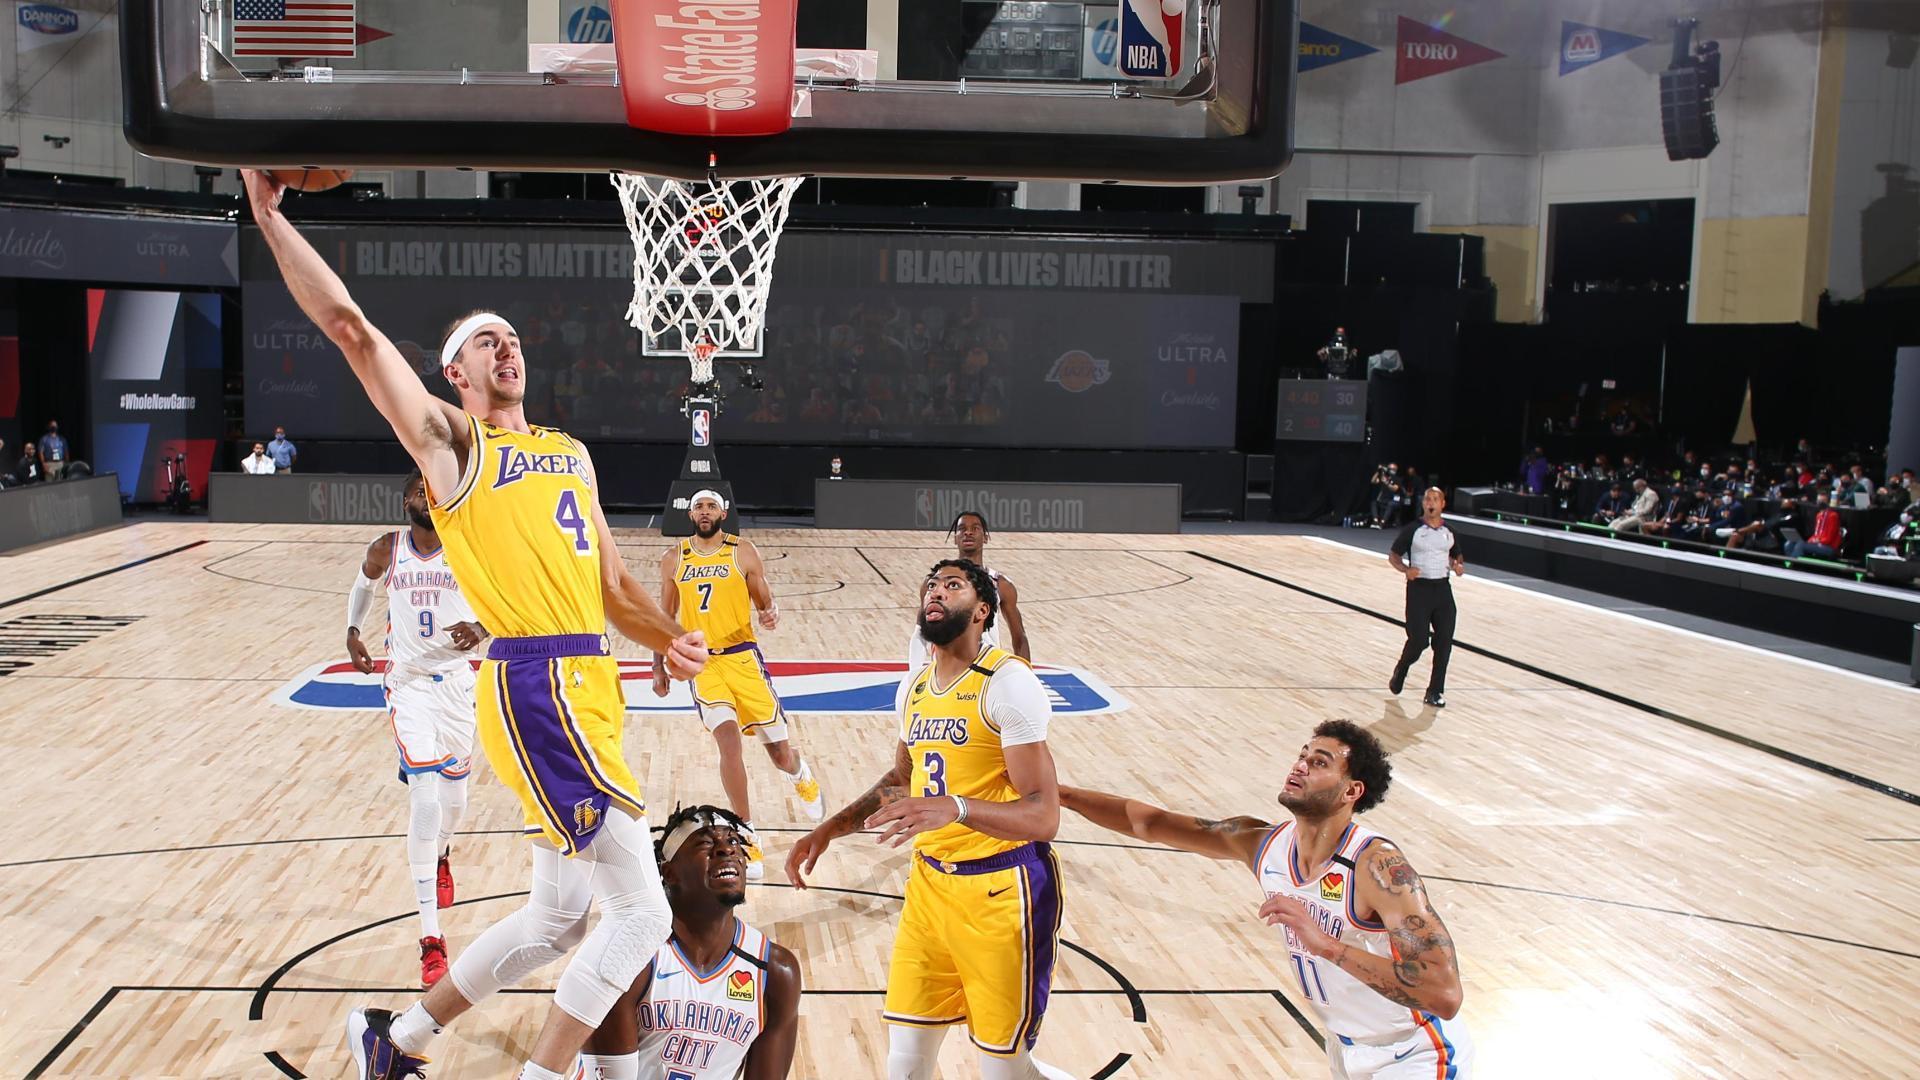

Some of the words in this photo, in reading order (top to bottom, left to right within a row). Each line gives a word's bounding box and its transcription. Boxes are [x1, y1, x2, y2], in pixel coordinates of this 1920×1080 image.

[23, 9, 76, 26] DANNON
[1127, 45, 1158, 69] NBA
[1298, 43, 1340, 56] amo
[1405, 42, 1458, 60] TORO
[136, 242, 191, 257] ULTRA
[356, 241, 445, 276] BLACK
[448, 241, 522, 277] LIVES
[526, 243, 634, 278] MATTER
[896, 249, 984, 284] BLACK
[987, 251, 1059, 286] LIVES
[1063, 253, 1172, 288] MATTER
[253, 333, 326, 350] ULTRA
[1157, 345, 1228, 363] ULTRA
[120, 392, 196, 411] #WholeNewGame
[1336, 392, 1354, 405] 30
[492, 446, 590, 489] LAKERS
[330, 483, 404, 521] NBASto
[936, 488, 1084, 529] NBAStore.com
[556, 490, 592, 556] 4
[679, 564, 730, 582] LAKERS
[410, 589, 441, 607] CITY
[697, 583, 713, 613] 7
[418, 609, 437, 640] 9
[956, 692, 977, 701] wish
[907, 713, 969, 747] LAKERS
[922, 750, 948, 798] 3
[1322, 889, 1342, 899] Love's
[1290, 951, 1330, 1005] 11
[729, 989, 753, 999] Love's
[637, 1000, 756, 1047] OKLAHOMA
[661, 1033, 719, 1069] CITY
